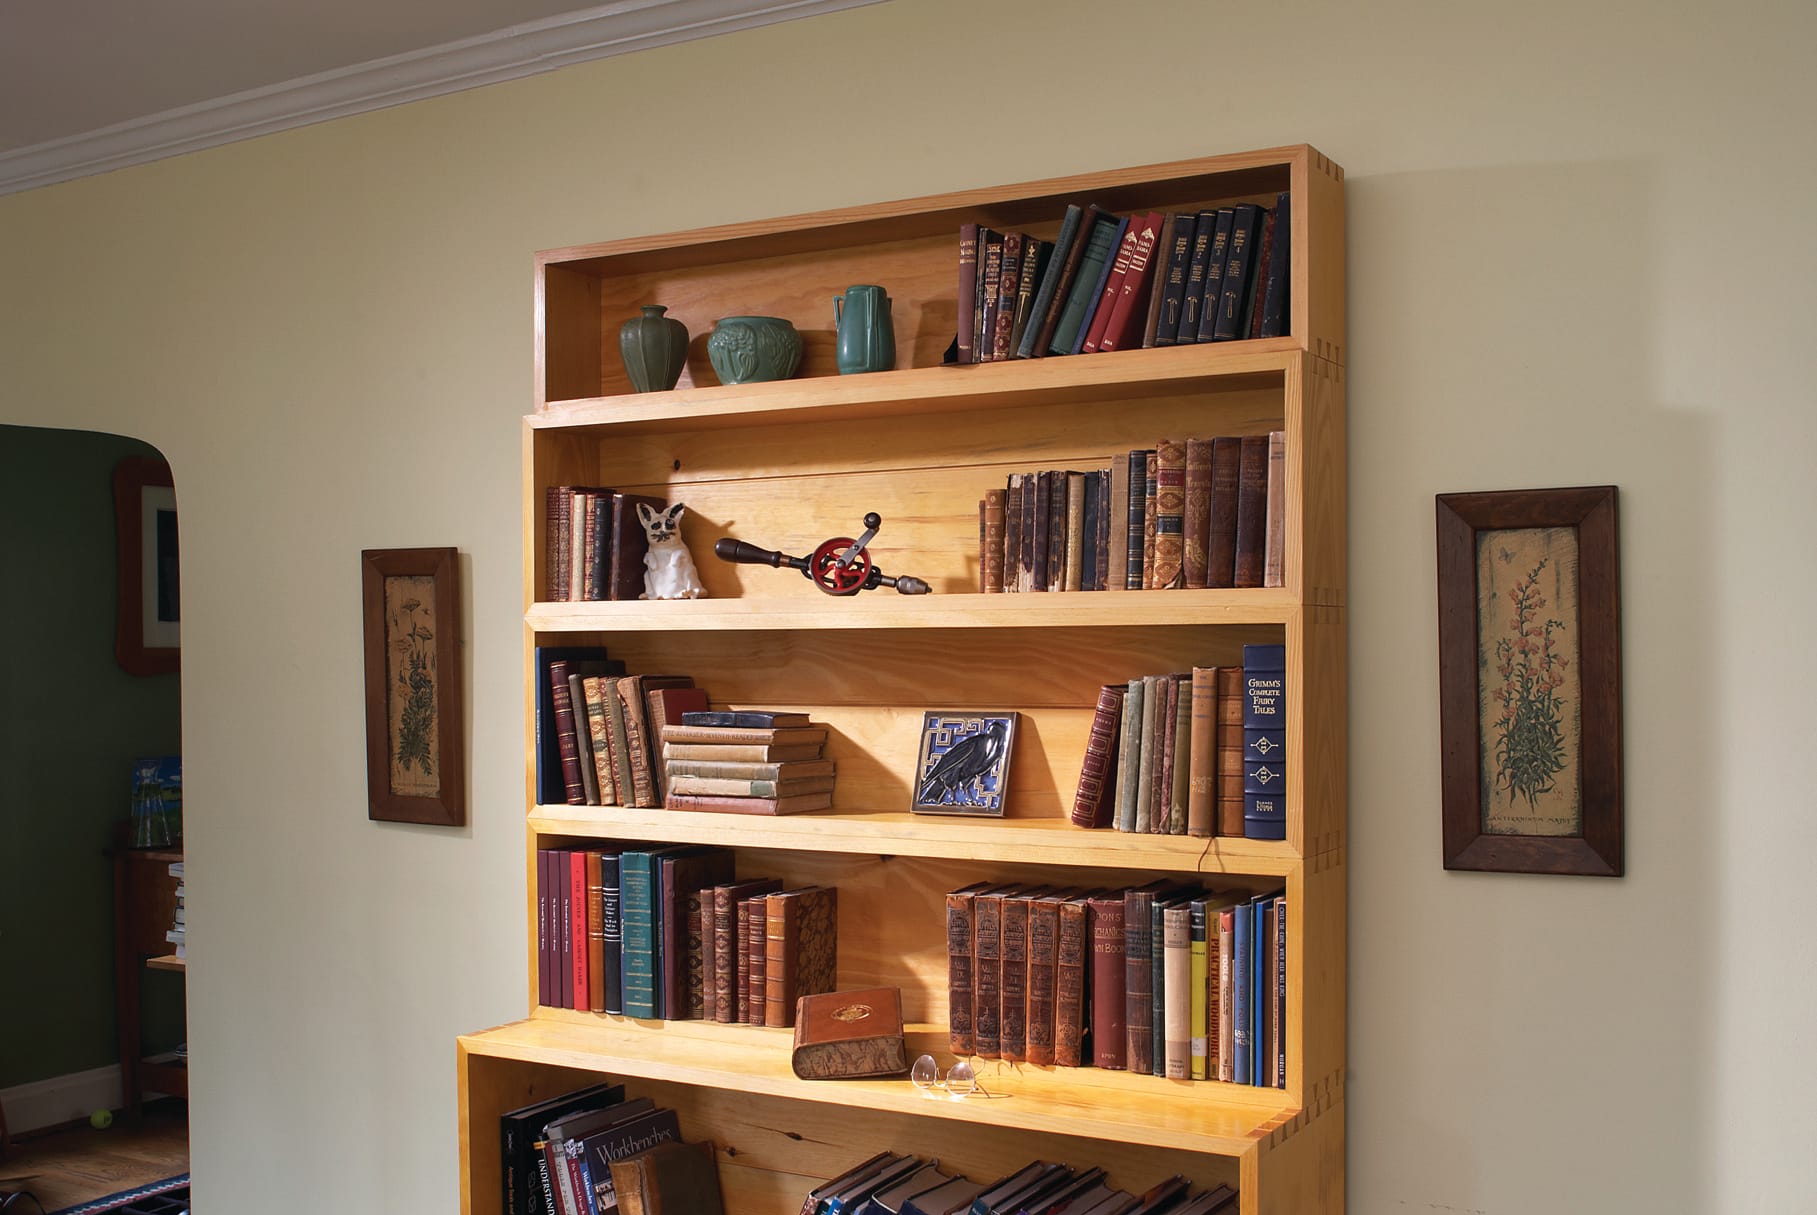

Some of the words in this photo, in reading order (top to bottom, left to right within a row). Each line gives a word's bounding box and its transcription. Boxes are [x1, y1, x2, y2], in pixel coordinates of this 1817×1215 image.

[1248, 679, 1281, 687] GRIMM'S
[1248, 688, 1280, 697] COMPLETE
[1252, 706, 1275, 715] TALES
[1253, 696, 1275, 706] FAIRY
[1210, 938, 1218, 996] PRACTICAL
[1210, 999, 1218, 1058] WOODWORK
[596, 1128, 673, 1166] Workbenches
[581, 1170, 594, 1204] Workbenches
